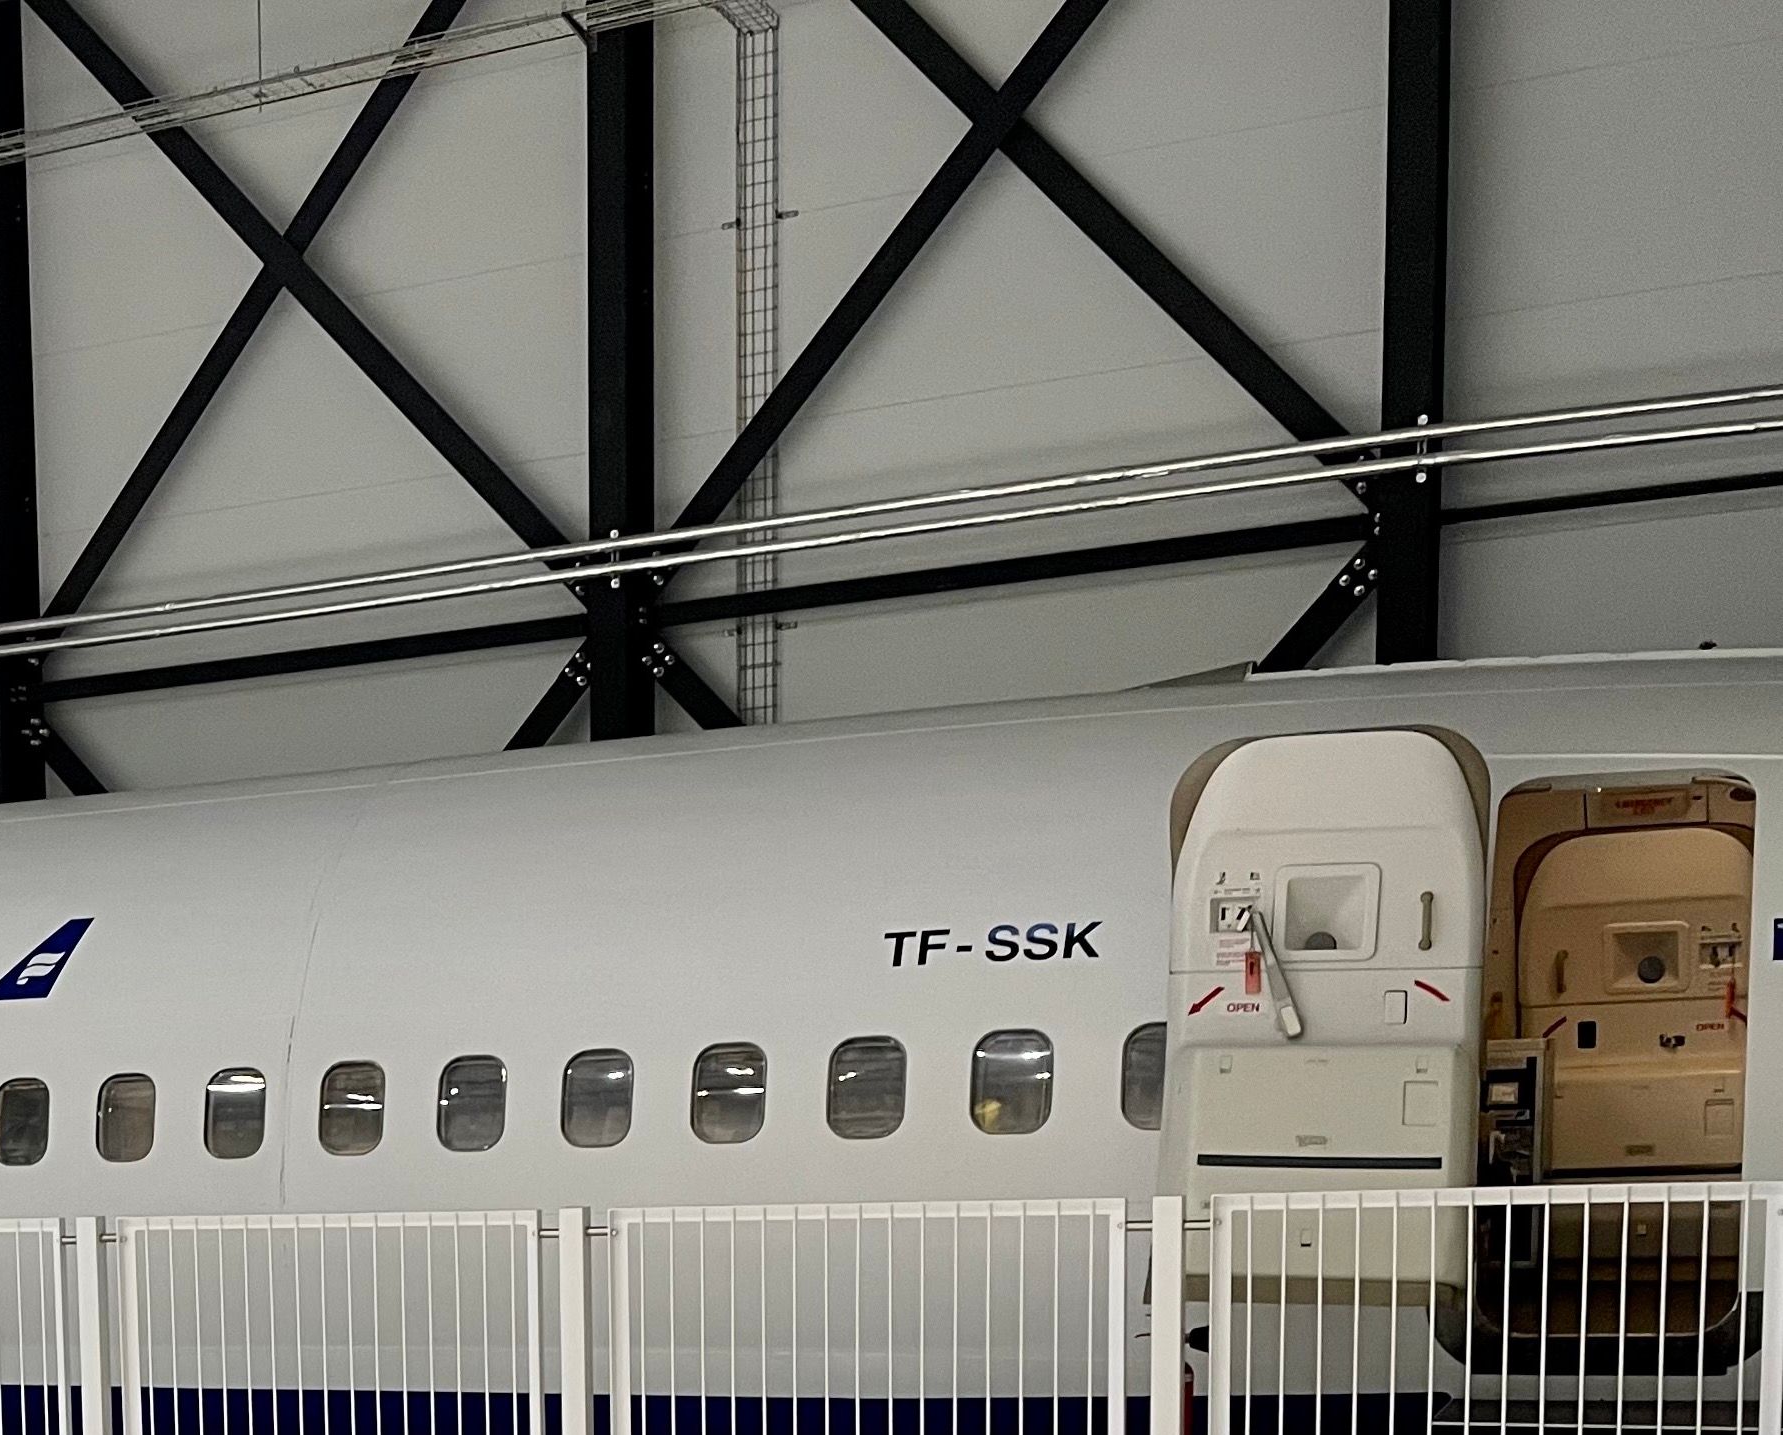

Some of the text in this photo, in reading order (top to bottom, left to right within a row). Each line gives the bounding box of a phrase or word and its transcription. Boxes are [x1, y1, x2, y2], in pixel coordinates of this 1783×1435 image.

[884, 921, 1103, 967] TF-SSK
[1226, 1002, 1260, 1013] OPEN
[1696, 1023, 1725, 1032] OPEN
